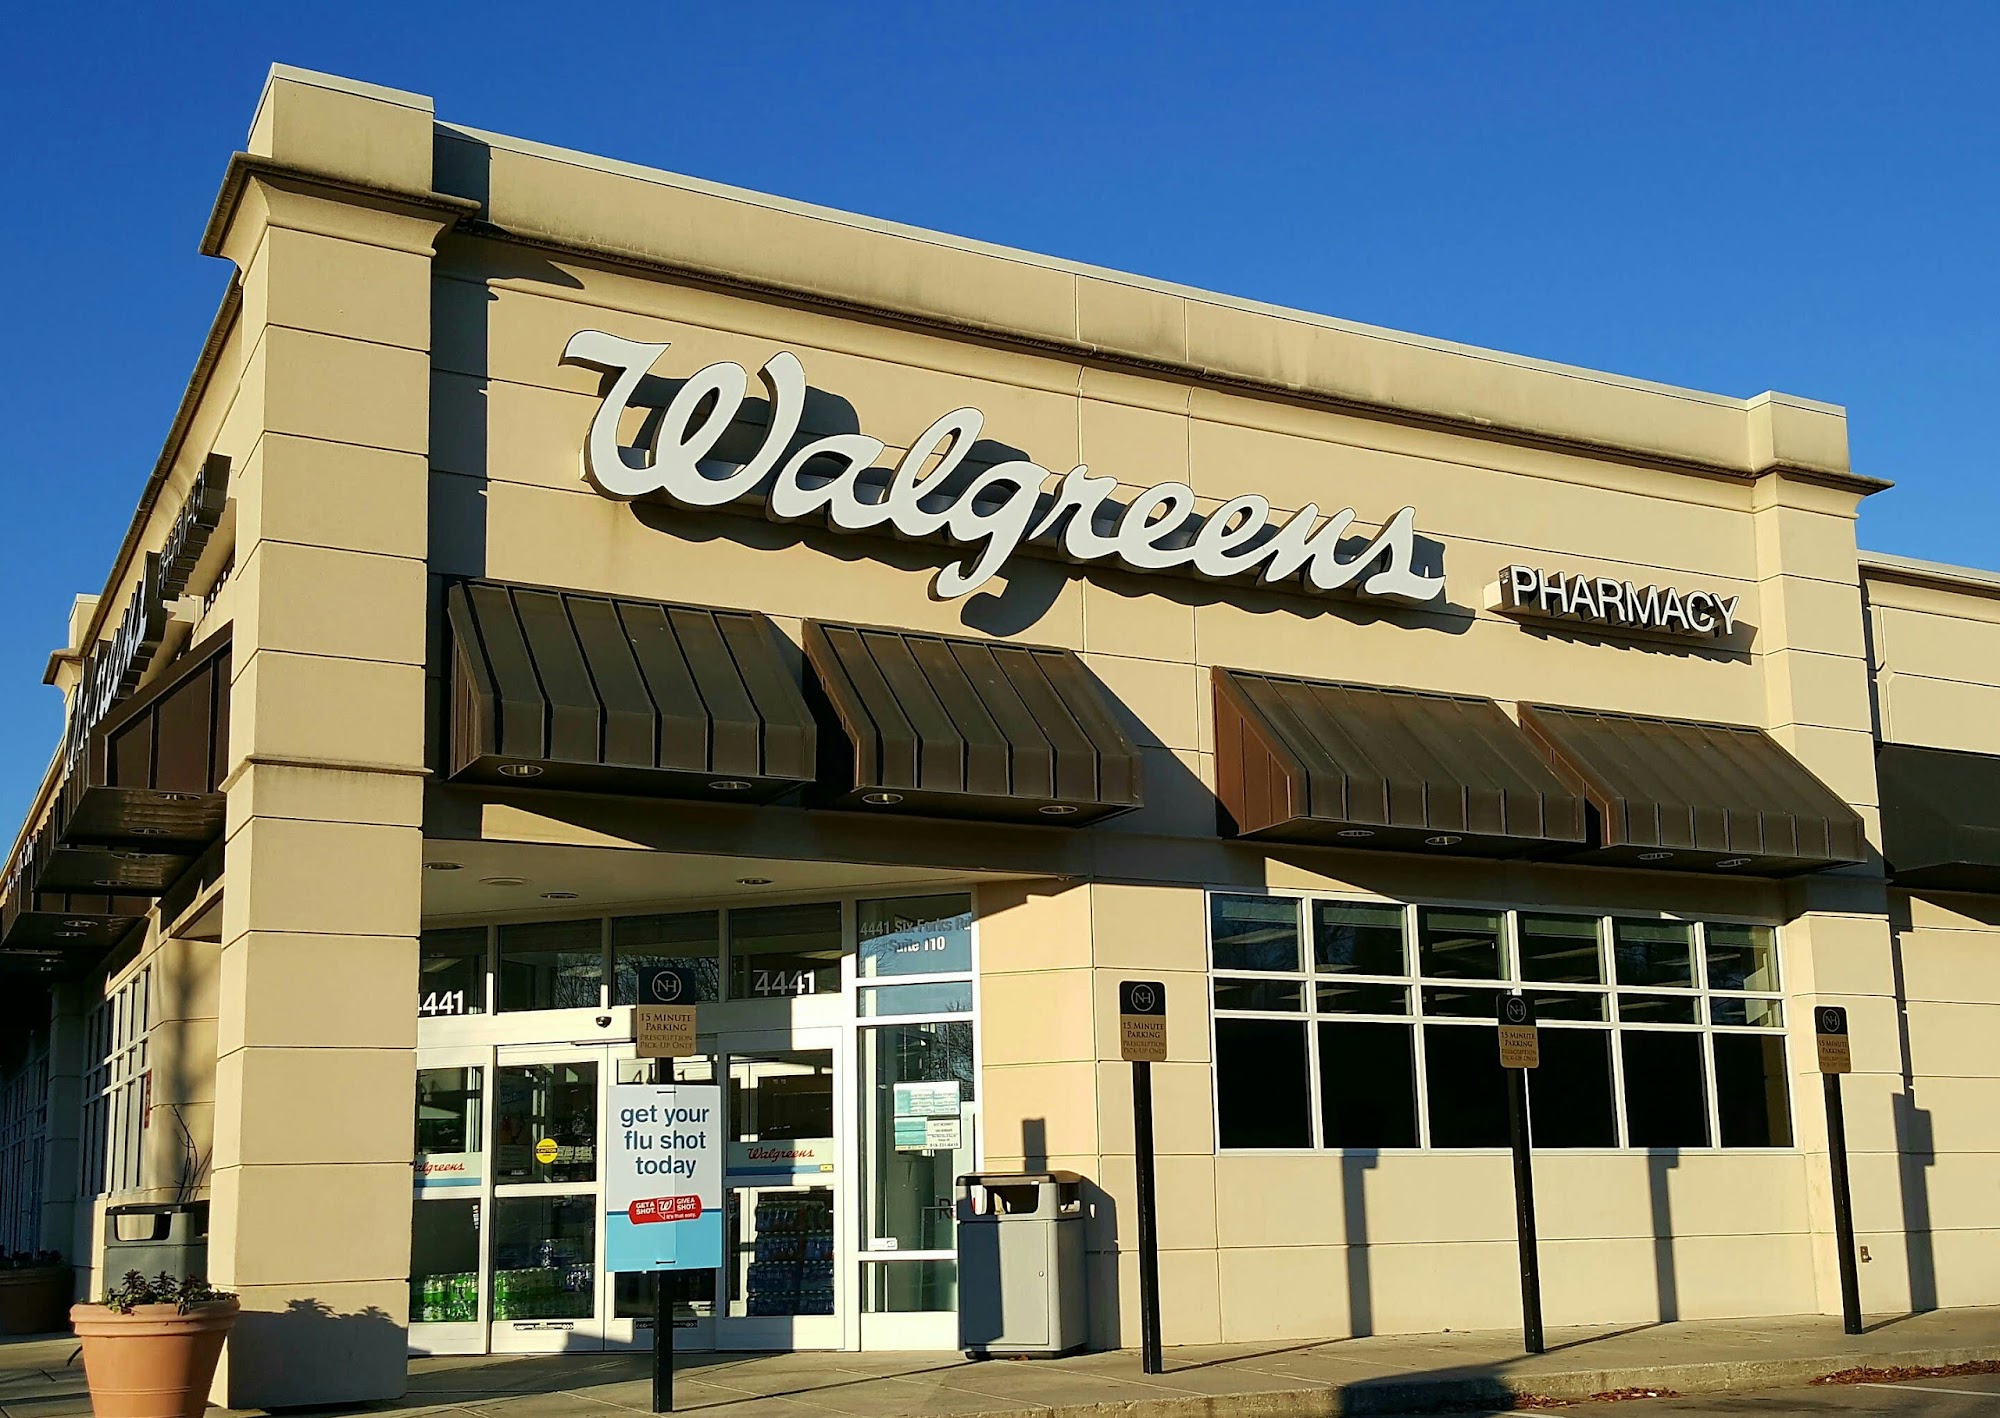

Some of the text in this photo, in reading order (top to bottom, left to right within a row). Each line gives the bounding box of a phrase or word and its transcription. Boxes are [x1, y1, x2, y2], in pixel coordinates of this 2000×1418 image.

[558, 330, 1446, 600] Walgreens
[1510, 565, 1740, 635] PHARMACY
[860, 920, 890, 935] 4441
[894, 916, 914, 933] Six
[917, 918, 952, 932] Forks
[889, 936, 946, 953] Suite 110
[755, 969, 815, 996] 4441
[641, 1013, 692, 1022] 15 MINUTE
[1134, 1022, 1164, 1030] MINUTE
[645, 1023, 687, 1031] PARKING
[1510, 1032, 1535, 1040] MINUTE
[620, 1104, 710, 1128] get your
[624, 1130, 706, 1150] flu shot
[747, 1147, 815, 1162] Walgreens
[413, 1160, 465, 1175] algreens
[635, 1155, 697, 1178] today
